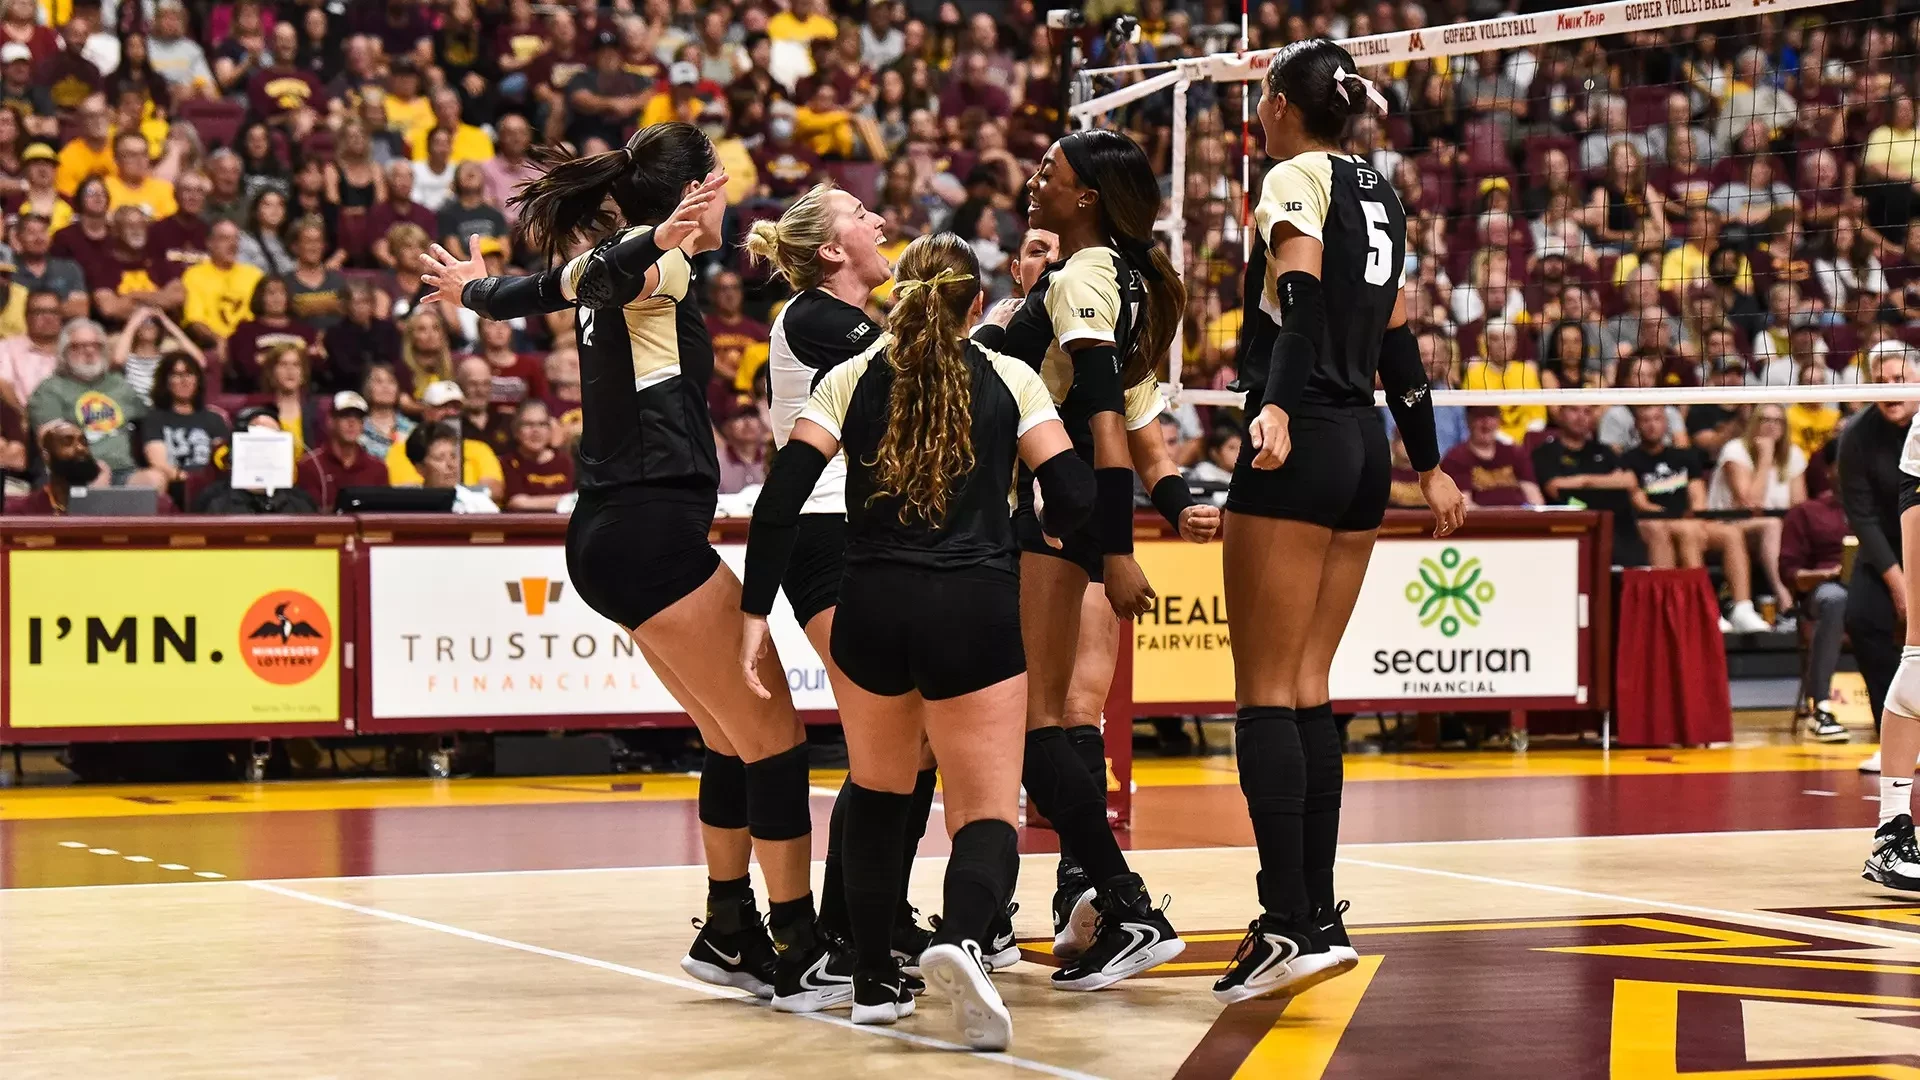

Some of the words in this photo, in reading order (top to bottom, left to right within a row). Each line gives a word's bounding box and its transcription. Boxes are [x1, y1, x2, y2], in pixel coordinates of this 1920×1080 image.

[1626, 2, 1663, 21] GOPHER
[1443, 26, 1477, 44] GOPHER
[1479, 18, 1537, 40] VOLLEYBALL
[1341, 38, 1390, 57] OLLEYBALL
[1357, 168, 1378, 189] P
[1359, 200, 1393, 287] 5
[1138, 595, 1229, 625] HEAL
[401, 632, 635, 662] TRUSTON
[1137, 634, 1231, 651] FAIRVIEW
[256, 656, 314, 667] LOTTERY
[1373, 647, 1531, 675] securian
[427, 673, 641, 693] FINANCIAL
[1403, 681, 1497, 694] FINANCIAL
